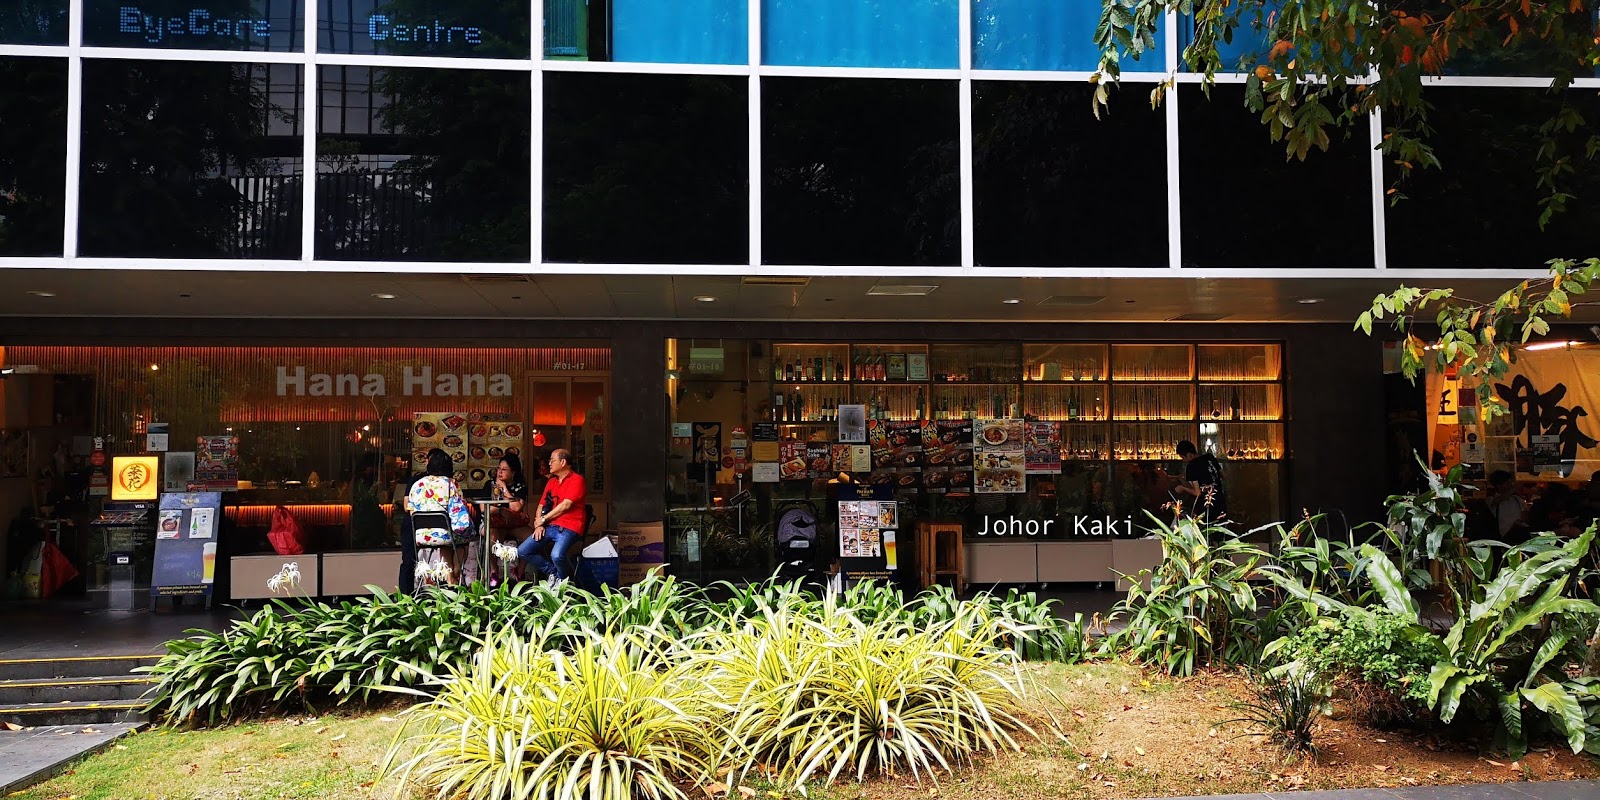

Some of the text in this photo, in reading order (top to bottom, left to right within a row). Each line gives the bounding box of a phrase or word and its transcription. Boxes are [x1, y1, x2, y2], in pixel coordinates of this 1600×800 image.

[119, 6, 482, 45] EyeCare Centre
[276, 366, 512, 396] Hana Hana
[553, 362, 585, 370] #01-17
